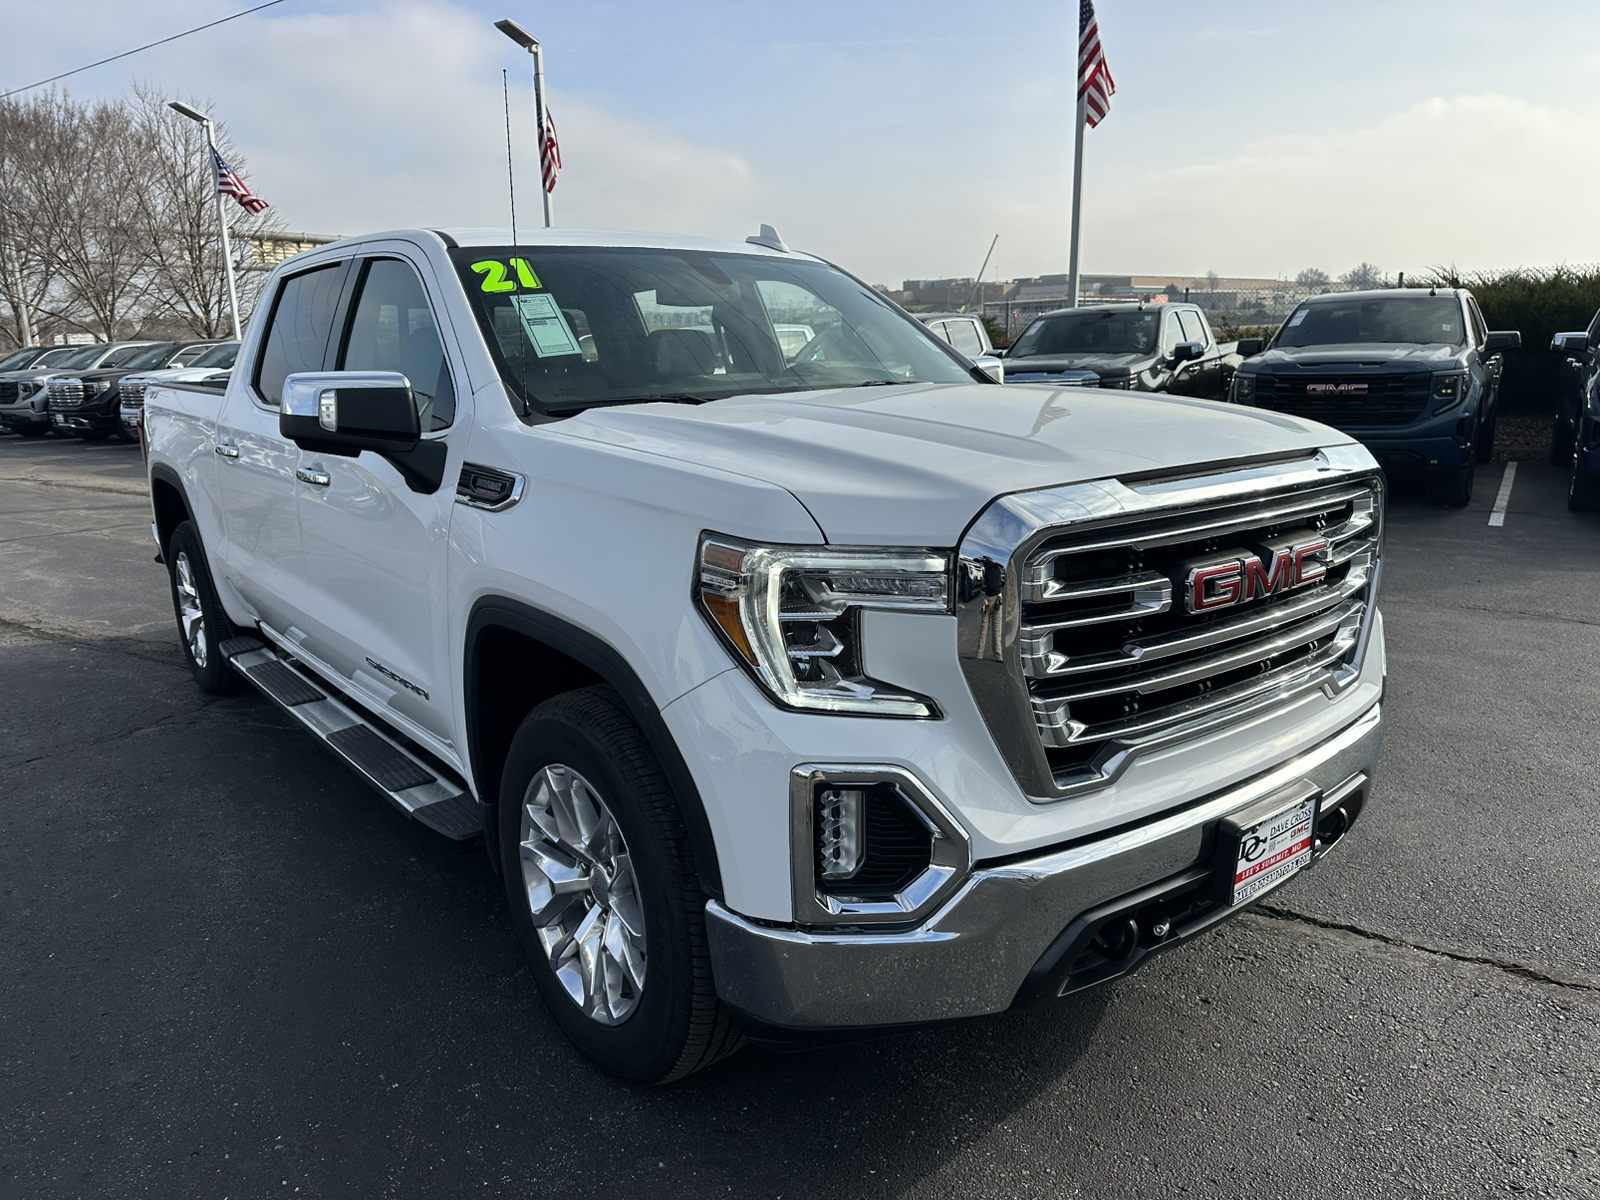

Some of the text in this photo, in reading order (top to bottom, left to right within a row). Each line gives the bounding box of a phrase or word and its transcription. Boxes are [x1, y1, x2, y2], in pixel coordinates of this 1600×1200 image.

[470, 257, 543, 293] 21
[1307, 384, 1368, 395] GMC
[1185, 534, 1328, 614] GMC
[365, 656, 430, 700] SIERRA
[1270, 820, 1289, 837] DAVE
[1290, 806, 1312, 826] CROSS
[1290, 822, 1310, 838] GMC
[1241, 863, 1260, 880] LEE'S
[1291, 842, 1302, 854] MO
